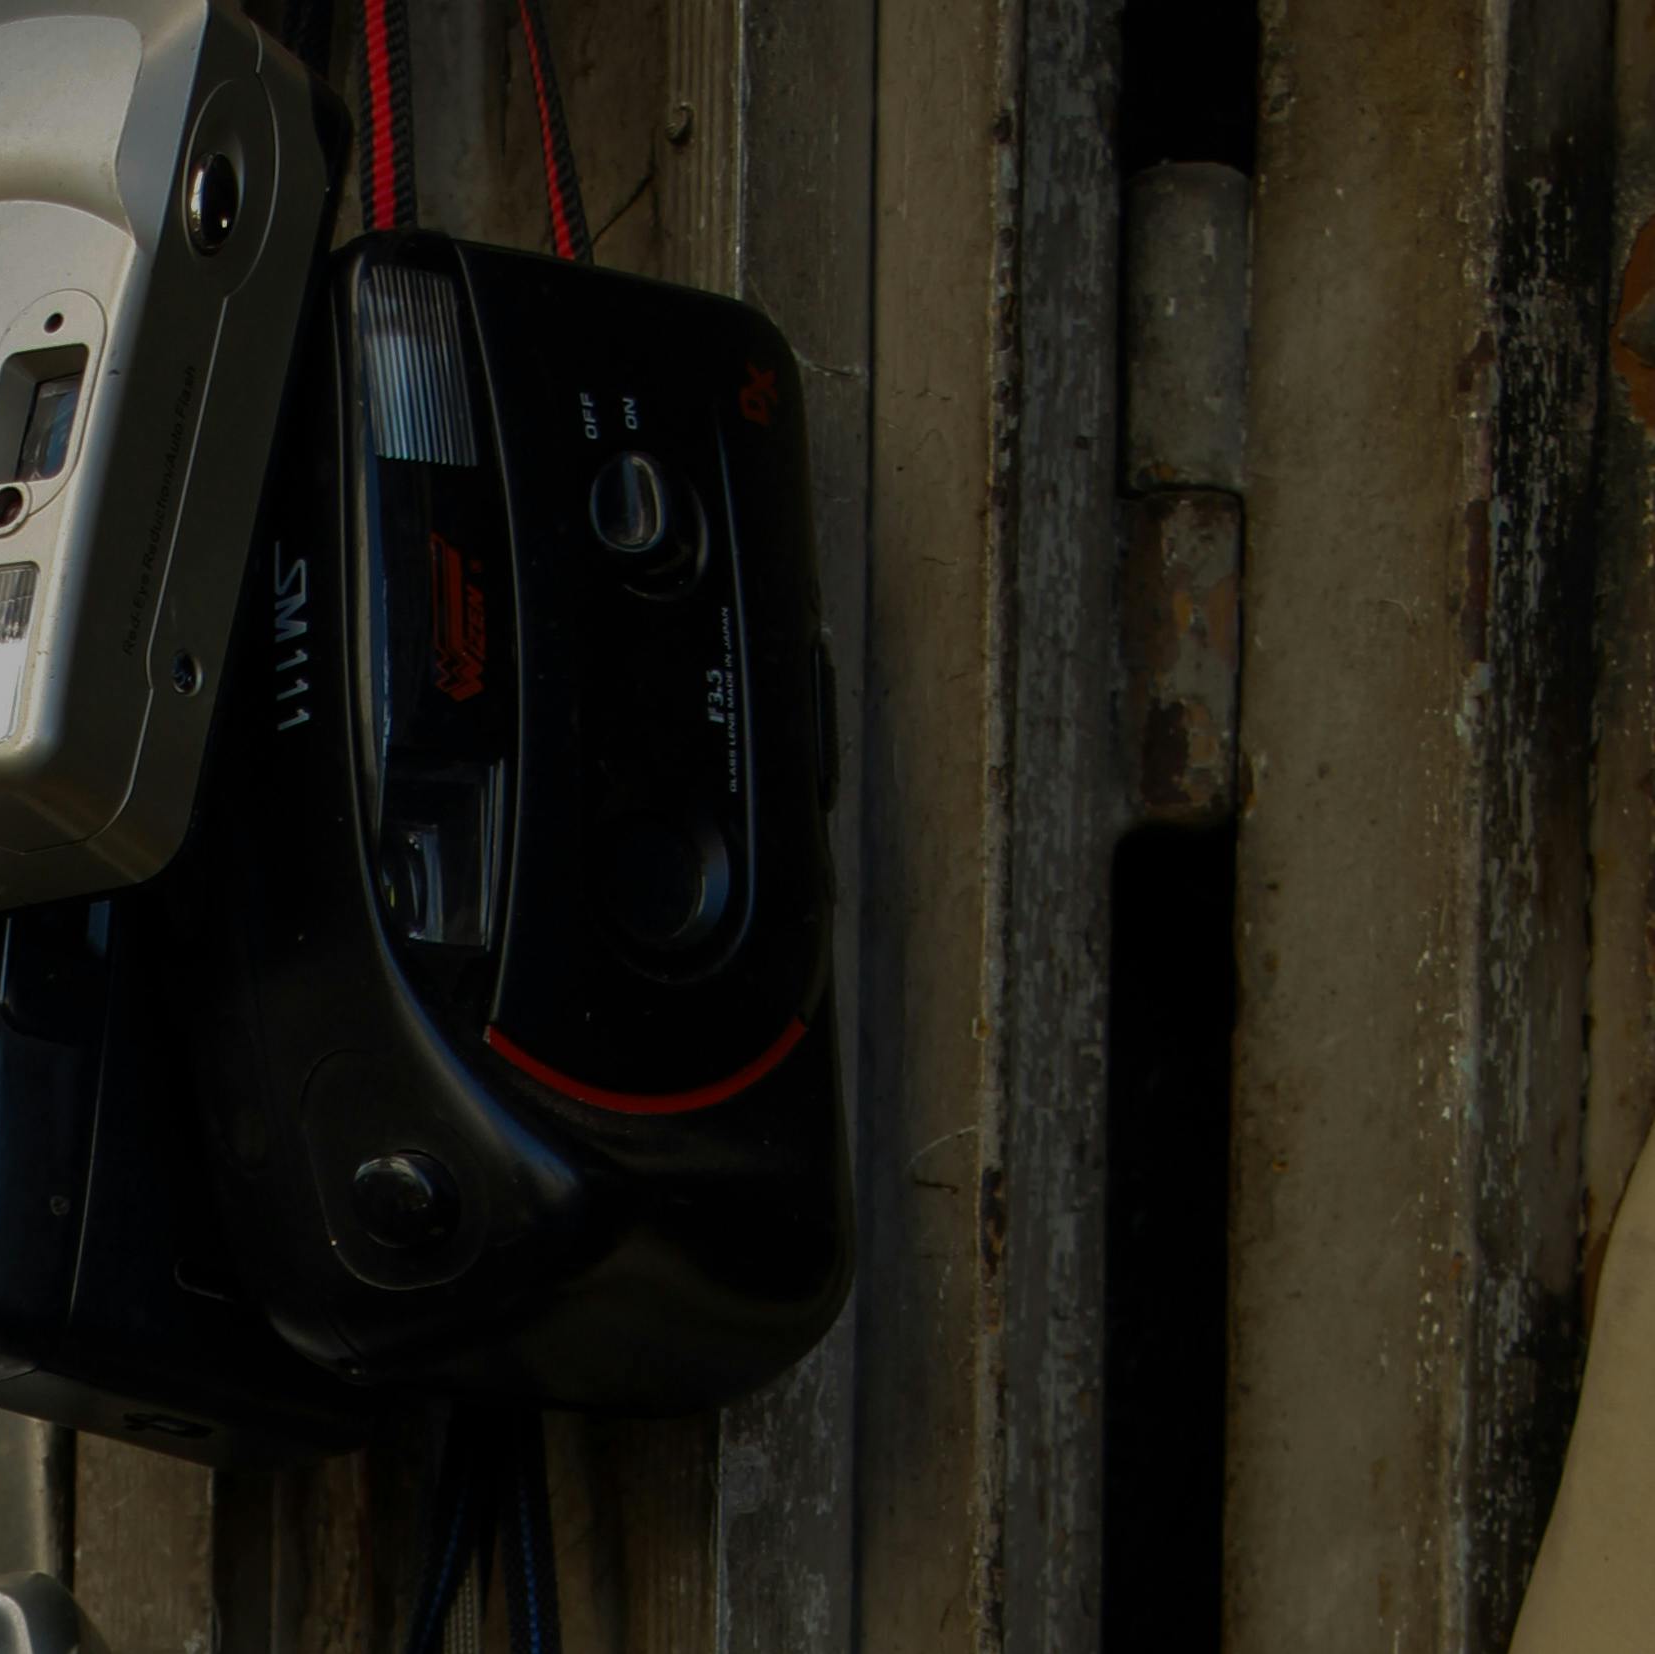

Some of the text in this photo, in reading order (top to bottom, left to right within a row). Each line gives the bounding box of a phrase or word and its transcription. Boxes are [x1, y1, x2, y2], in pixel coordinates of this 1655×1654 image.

[579, 391, 600, 441] OFF
[622, 397, 640, 431] ON
[720, 605, 732, 651] JAPAN
[723, 671, 736, 709] MADE
[725, 712, 737, 746] LENS
[726, 748, 738, 793] GLASS
